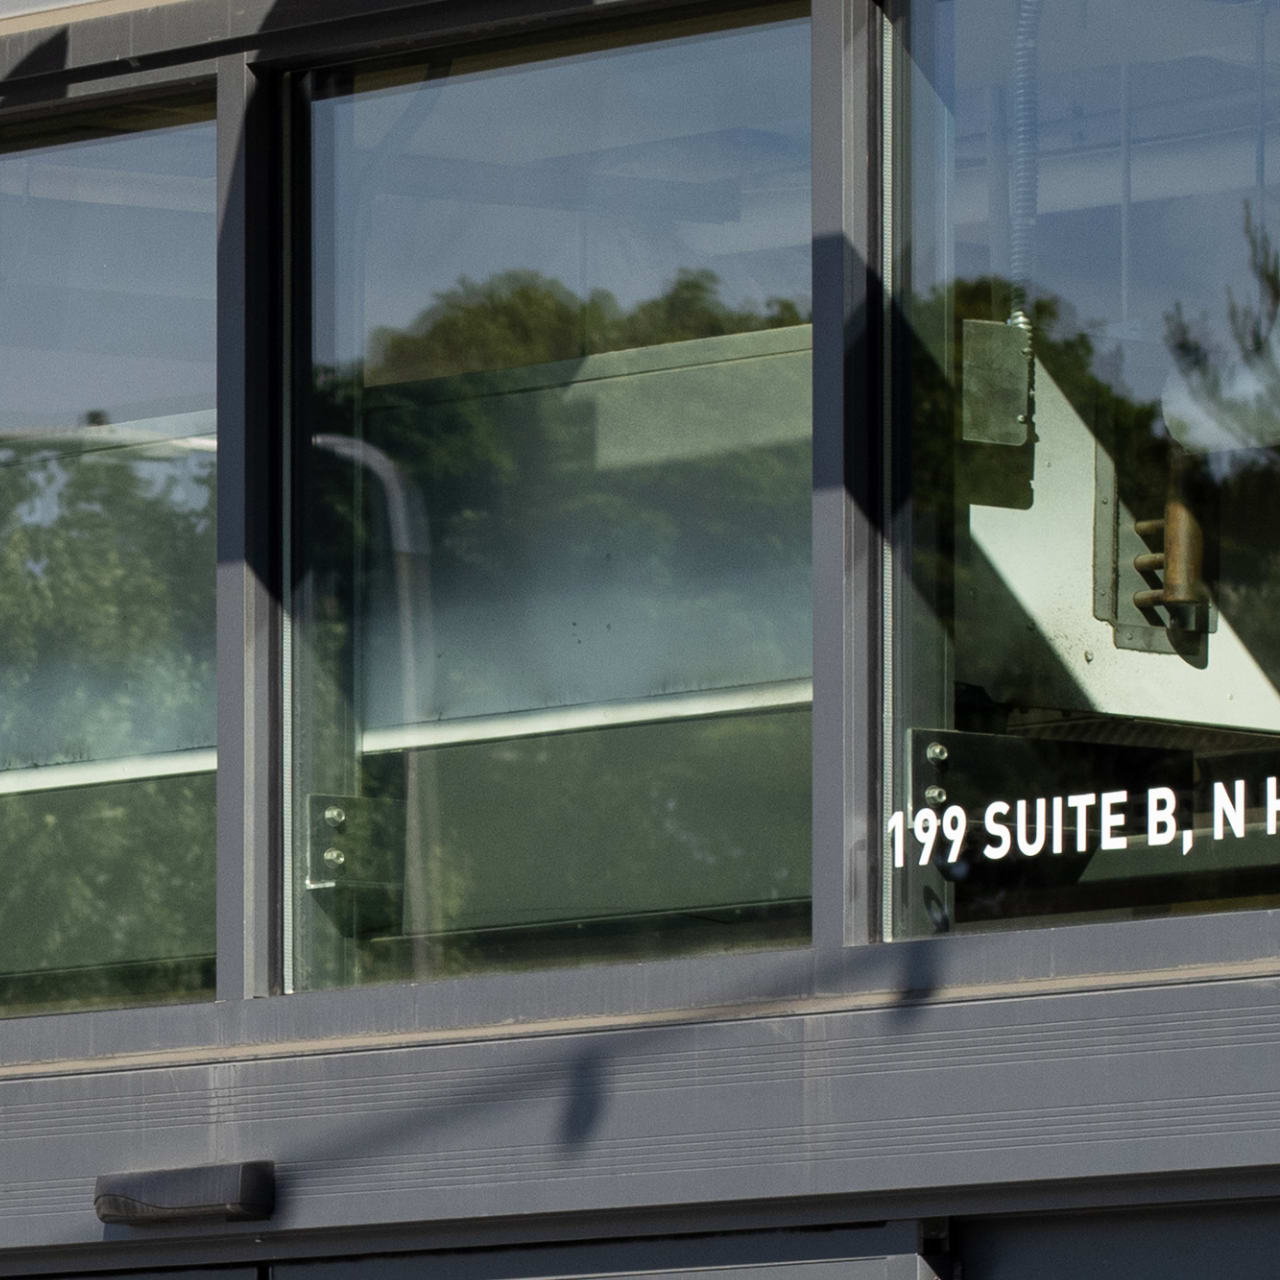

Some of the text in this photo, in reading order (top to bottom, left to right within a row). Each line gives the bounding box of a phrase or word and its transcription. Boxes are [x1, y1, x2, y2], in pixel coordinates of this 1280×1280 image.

[887, 804, 967, 868] 199
[983, 790, 1128, 860] SUITE
[1147, 786, 1194, 856] B,
[1213, 780, 1245, 840] N
